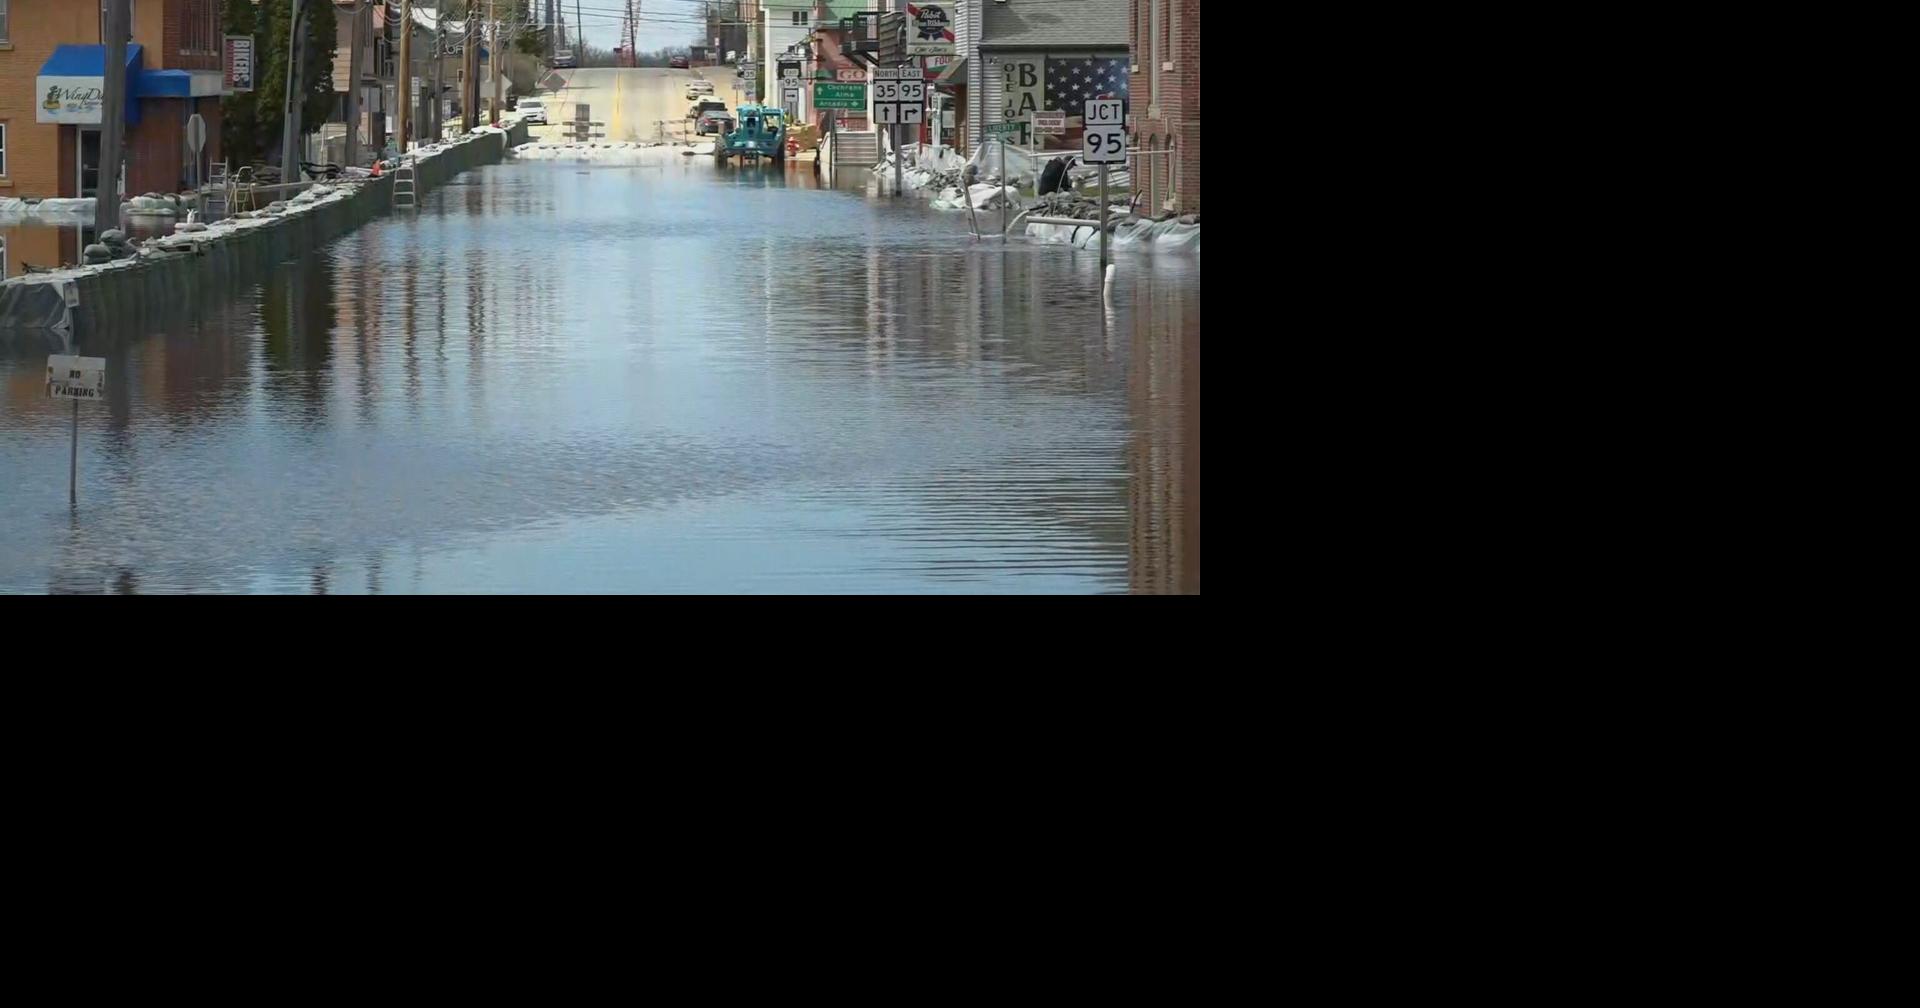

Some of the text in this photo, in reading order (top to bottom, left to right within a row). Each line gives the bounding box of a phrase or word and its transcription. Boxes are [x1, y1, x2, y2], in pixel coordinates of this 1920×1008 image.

[920, 9, 941, 19] Pabst
[232, 40, 250, 82] BIKERS
[785, 79, 798, 87] 95
[1004, 63, 1015, 92] OLE
[57, 86, 105, 105] WingDa
[877, 85, 896, 98] 35
[901, 85, 922, 98] 95
[1018, 63, 1039, 145] BAR
[1088, 104, 1120, 120] JCT
[1087, 133, 1122, 154] 95
[69, 370, 81, 379] NO
[55, 385, 94, 398] PARKING
